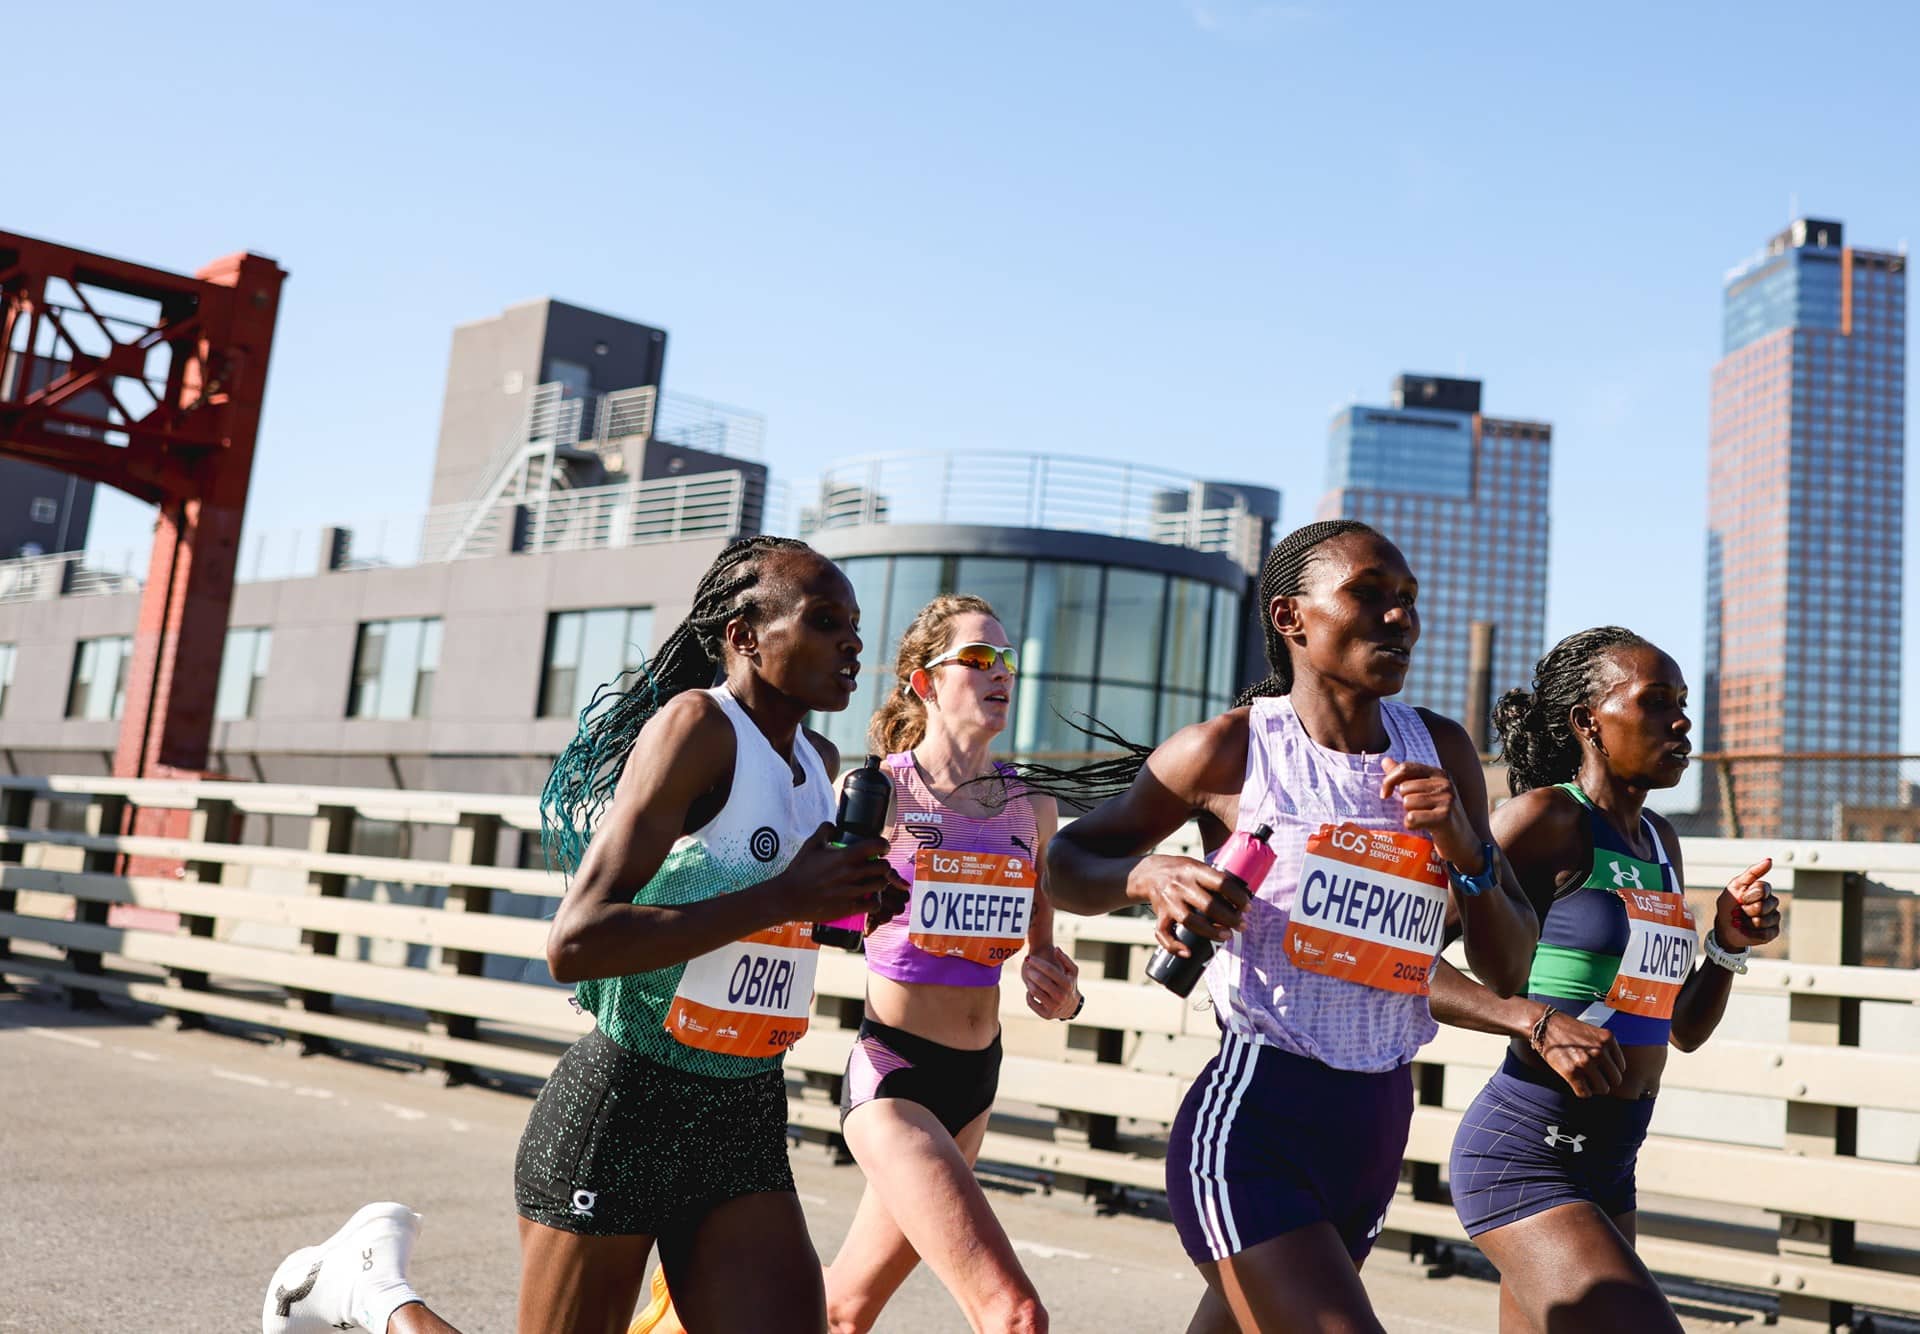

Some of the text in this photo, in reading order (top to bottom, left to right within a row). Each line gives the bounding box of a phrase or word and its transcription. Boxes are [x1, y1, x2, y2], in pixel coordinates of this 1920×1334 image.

[1373, 834, 1394, 844] TATA
[1369, 850, 1401, 863] SERVICES
[1371, 842, 1418, 859] CONSULTANCY
[932, 854, 960, 874] tcs
[1004, 871, 1024, 879] TATA
[920, 890, 1026, 933] O'KEEFFE
[1302, 869, 1444, 946] CHEPKIRUI
[1639, 931, 1693, 979] LOKEDI
[728, 954, 796, 1010] OBIRI
[1393, 962, 1427, 982] 2025
